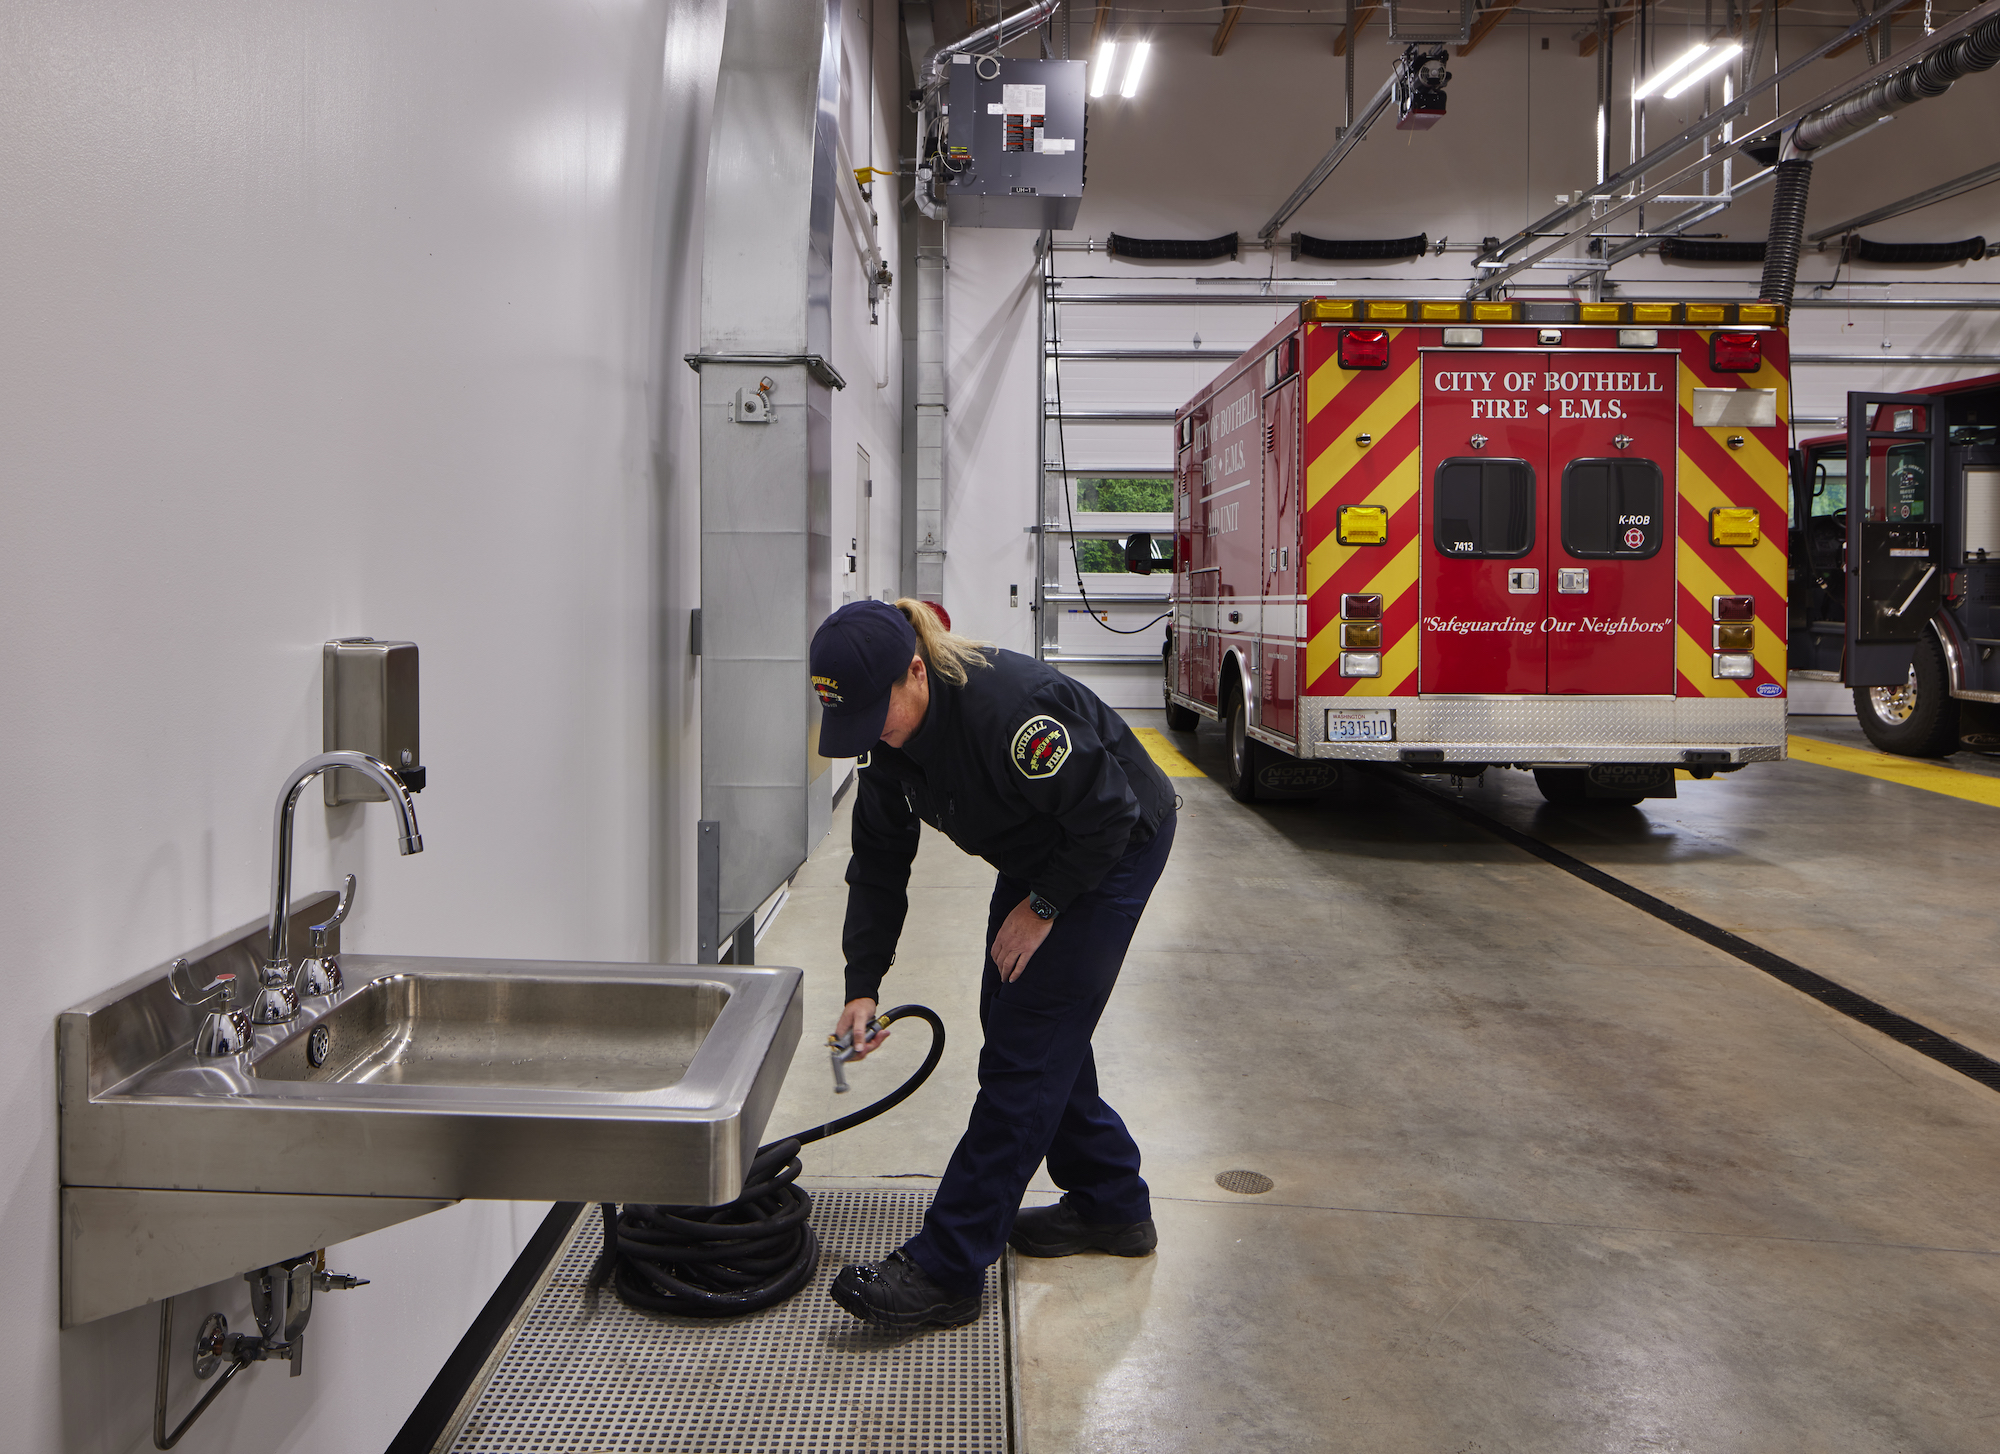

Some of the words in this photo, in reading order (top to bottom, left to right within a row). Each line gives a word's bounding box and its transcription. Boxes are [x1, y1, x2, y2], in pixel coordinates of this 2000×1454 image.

[1434, 371, 1496, 392] CITY
[1503, 371, 1537, 392] OF
[1543, 372, 1664, 392] BOTHELL
[1471, 399, 1529, 419] FIRE
[1559, 398, 1628, 419] E.M.S.
[1194, 421, 1209, 453] CITY
[1210, 414, 1219, 444] OF
[1220, 389, 1258, 438] BOTHELL
[1202, 454, 1217, 487] FIRE
[1224, 440, 1246, 476] E.M.S.
[1207, 509, 1219, 538] AID
[1220, 501, 1240, 535] UNIT
[1618, 515, 1650, 525] K-ROB
[1453, 541, 1474, 551] 7413
[1423, 616, 1536, 636] "Safeguarding
[1540, 617, 1576, 633] Our
[1578, 617, 1672, 636] Neighbors"
[1340, 720, 1388, 736] 53151D
[1016, 720, 1048, 760] BOTHELL
[1045, 745, 1066, 770] FIRE
[1268, 766, 1329, 776] NORTH
[1597, 775, 1649, 784] STAR
[1598, 765, 1660, 775] NORTH
[1267, 776, 1317, 785] STAR
